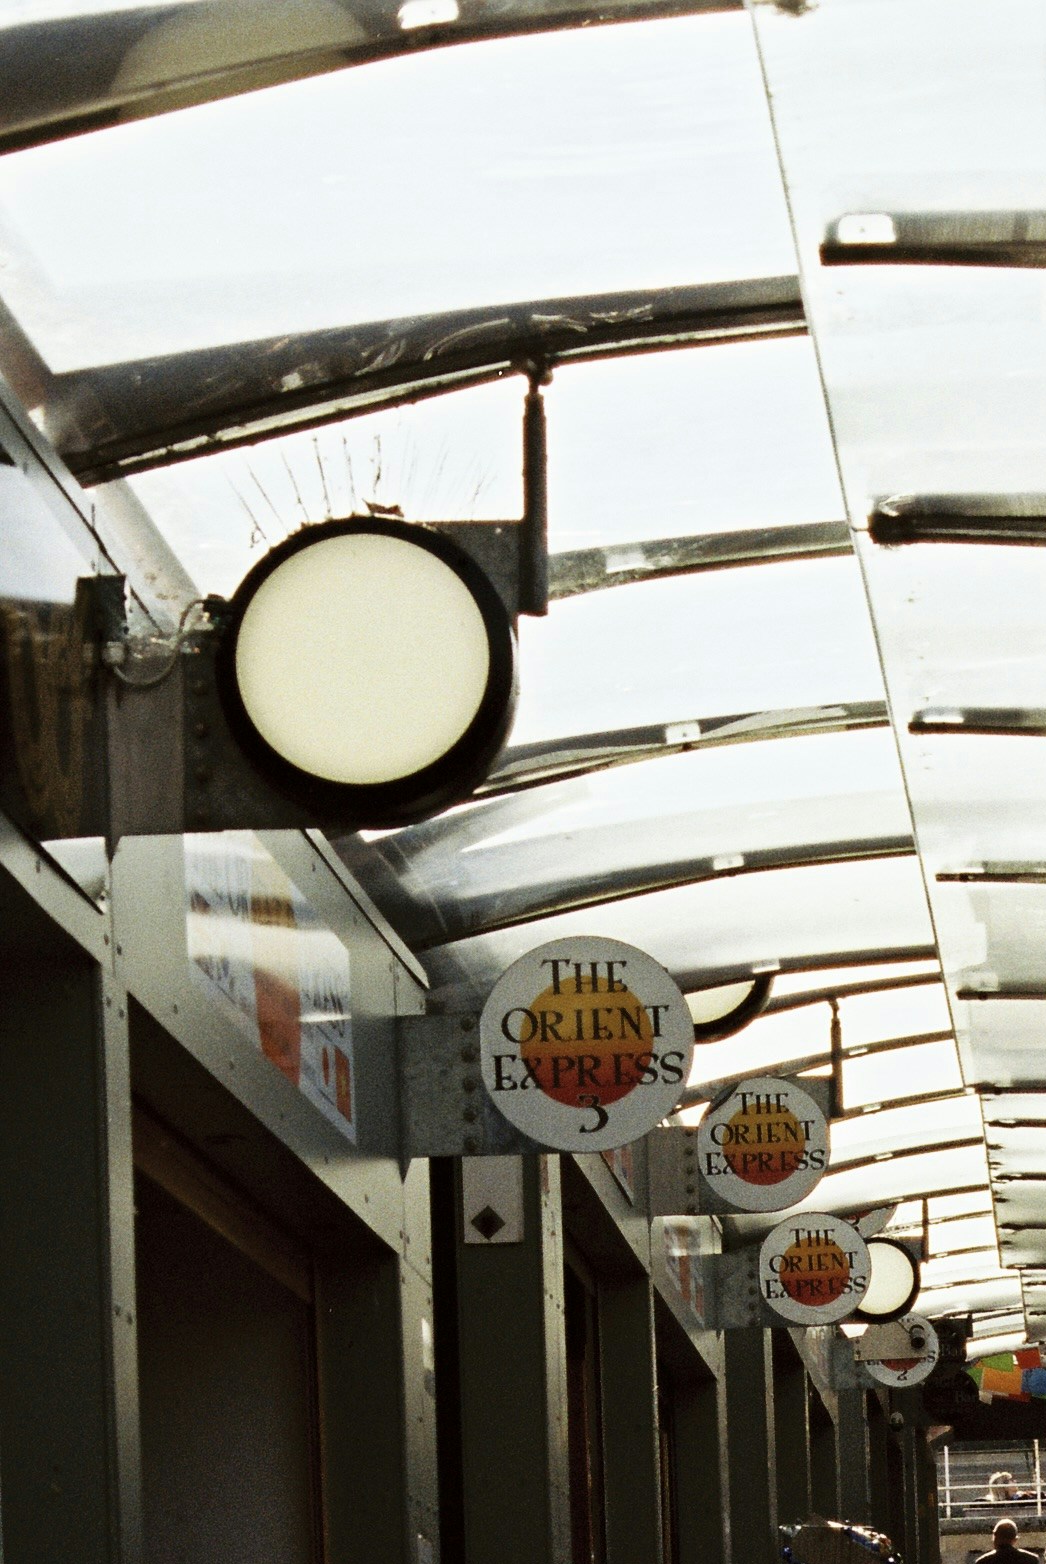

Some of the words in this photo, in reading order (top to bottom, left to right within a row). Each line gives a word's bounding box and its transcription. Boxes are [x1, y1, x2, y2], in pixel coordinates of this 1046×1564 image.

[541, 958, 629, 996] THE
[501, 1004, 669, 1044] ORIENT
[492, 1051, 685, 1092] EXPRESS
[578, 1094, 609, 1134] 3
[735, 1092, 789, 1116] THE
[710, 1120, 815, 1146] ORIENT
[705, 1149, 826, 1176] EXPRESS
[789, 1228, 836, 1249] THE
[769, 1251, 858, 1274] ORIENT
[764, 1276, 867, 1300] EXPRESS
